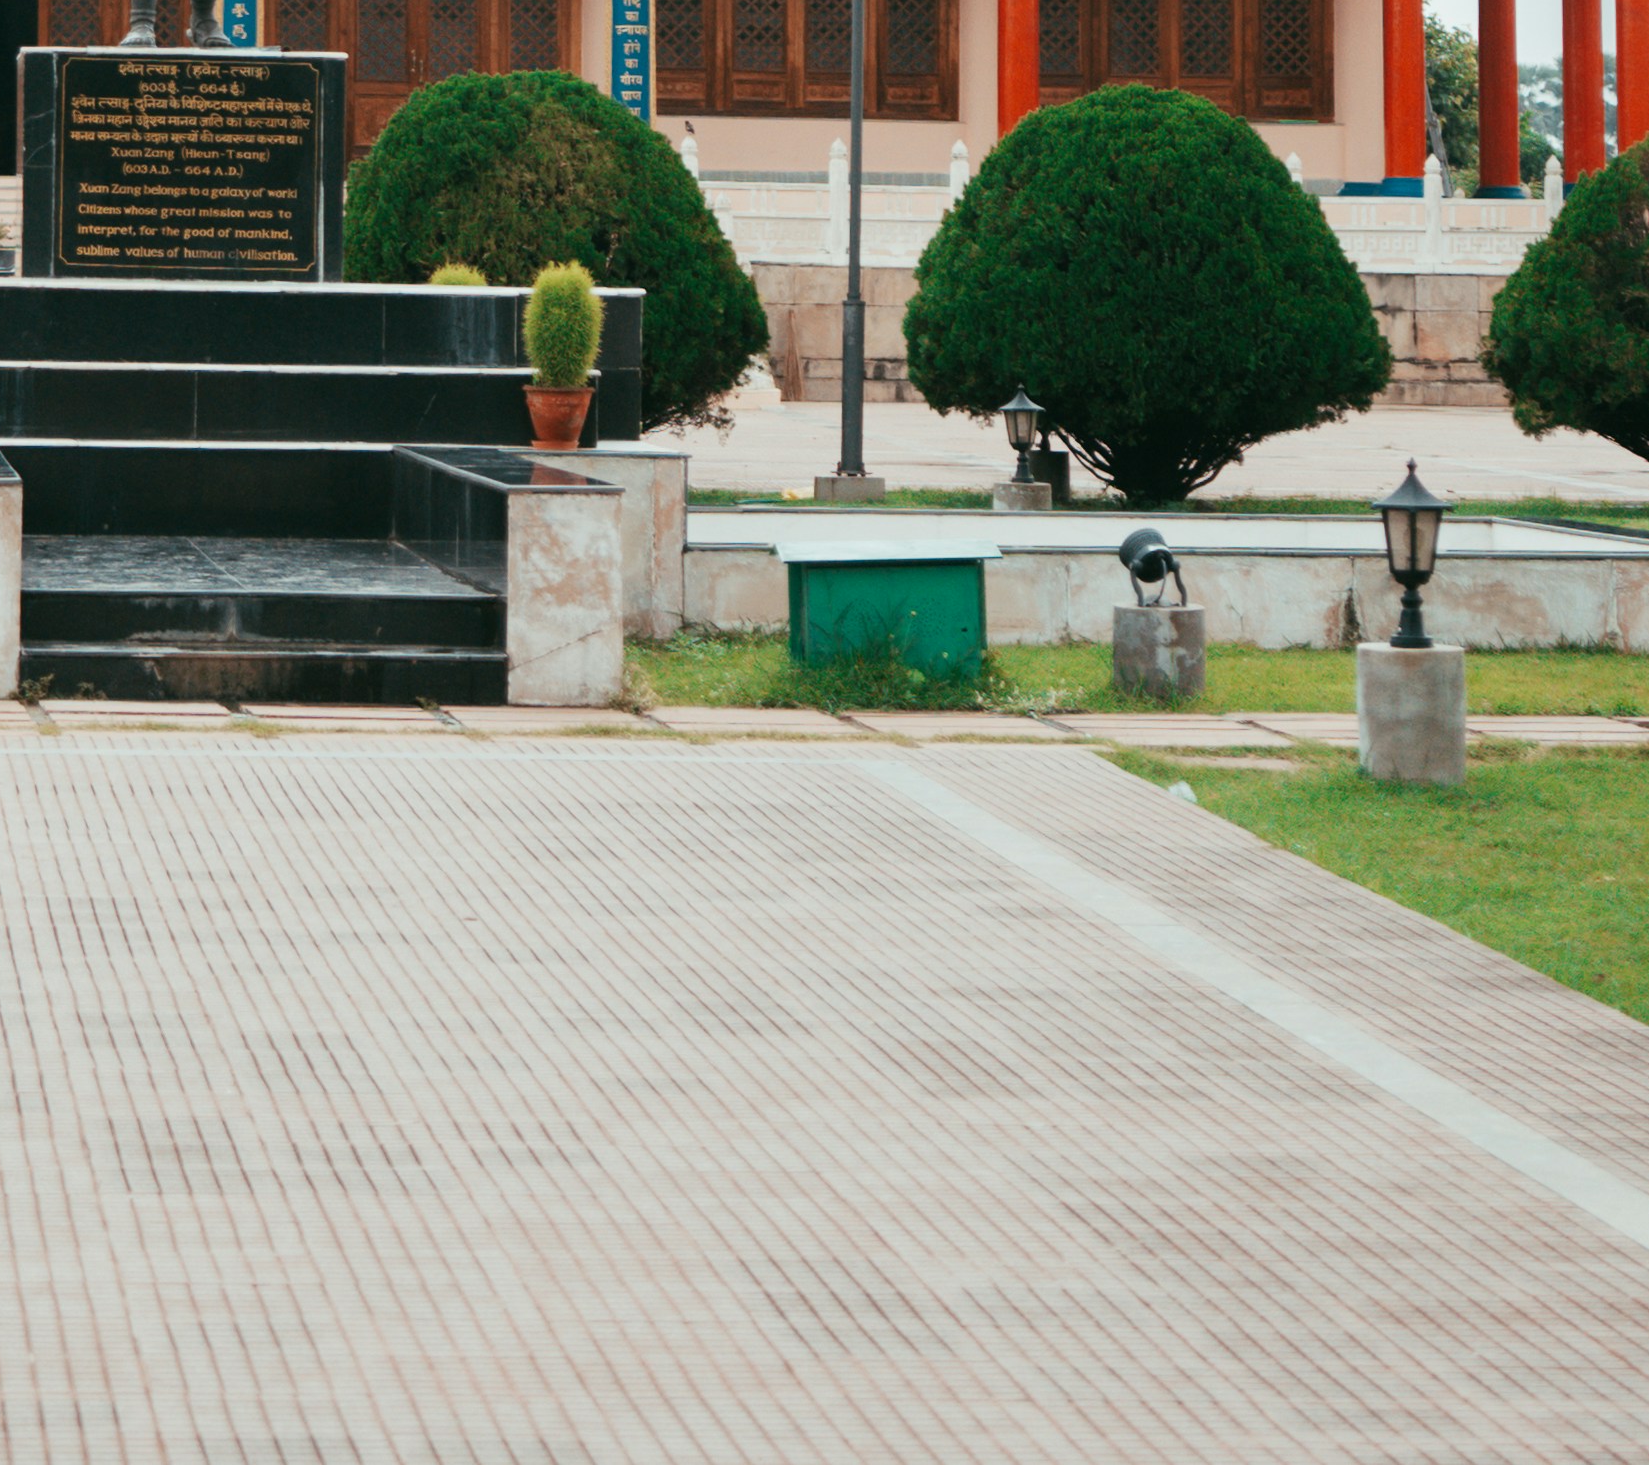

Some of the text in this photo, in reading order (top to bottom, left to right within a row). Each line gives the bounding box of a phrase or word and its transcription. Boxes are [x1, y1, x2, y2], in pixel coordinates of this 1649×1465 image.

[625, 11, 639, 22] का
[624, 39, 640, 55] होने
[624, 58, 639, 69] का
[620, 71, 643, 86] गौरव
[140, 81, 167, 93] (603
[199, 83, 228, 94] 664
[169, 95, 180, 109] के
[226, 116, 241, 127] का
[132, 129, 142, 141] के
[200, 130, 213, 143] की
[257, 135, 285, 145] करना
[111, 147, 142, 158] Xuan
[144, 147, 175, 161] Zang
[122, 162, 148, 176] (603
[149, 165, 171, 174] A.D.
[185, 166, 211, 176] 664
[214, 164, 243, 178] A.D.)
[79, 182, 109, 194] Xuan
[111, 184, 142, 197] Zang
[144, 185, 187, 197] belongs
[189, 187, 199, 195] to
[211, 187, 250, 199] galaxy
[252, 188, 265, 197] of
[78, 204, 292, 219] Citizens whose great mission was to
[139, 225, 158, 236] for
[162, 226, 180, 237] the
[183, 228, 214, 239] good
[217, 228, 232, 238] of
[77, 245, 120, 257] sublime
[125, 246, 164, 258] values
[167, 247, 179, 258] of
[184, 248, 225, 259] human
